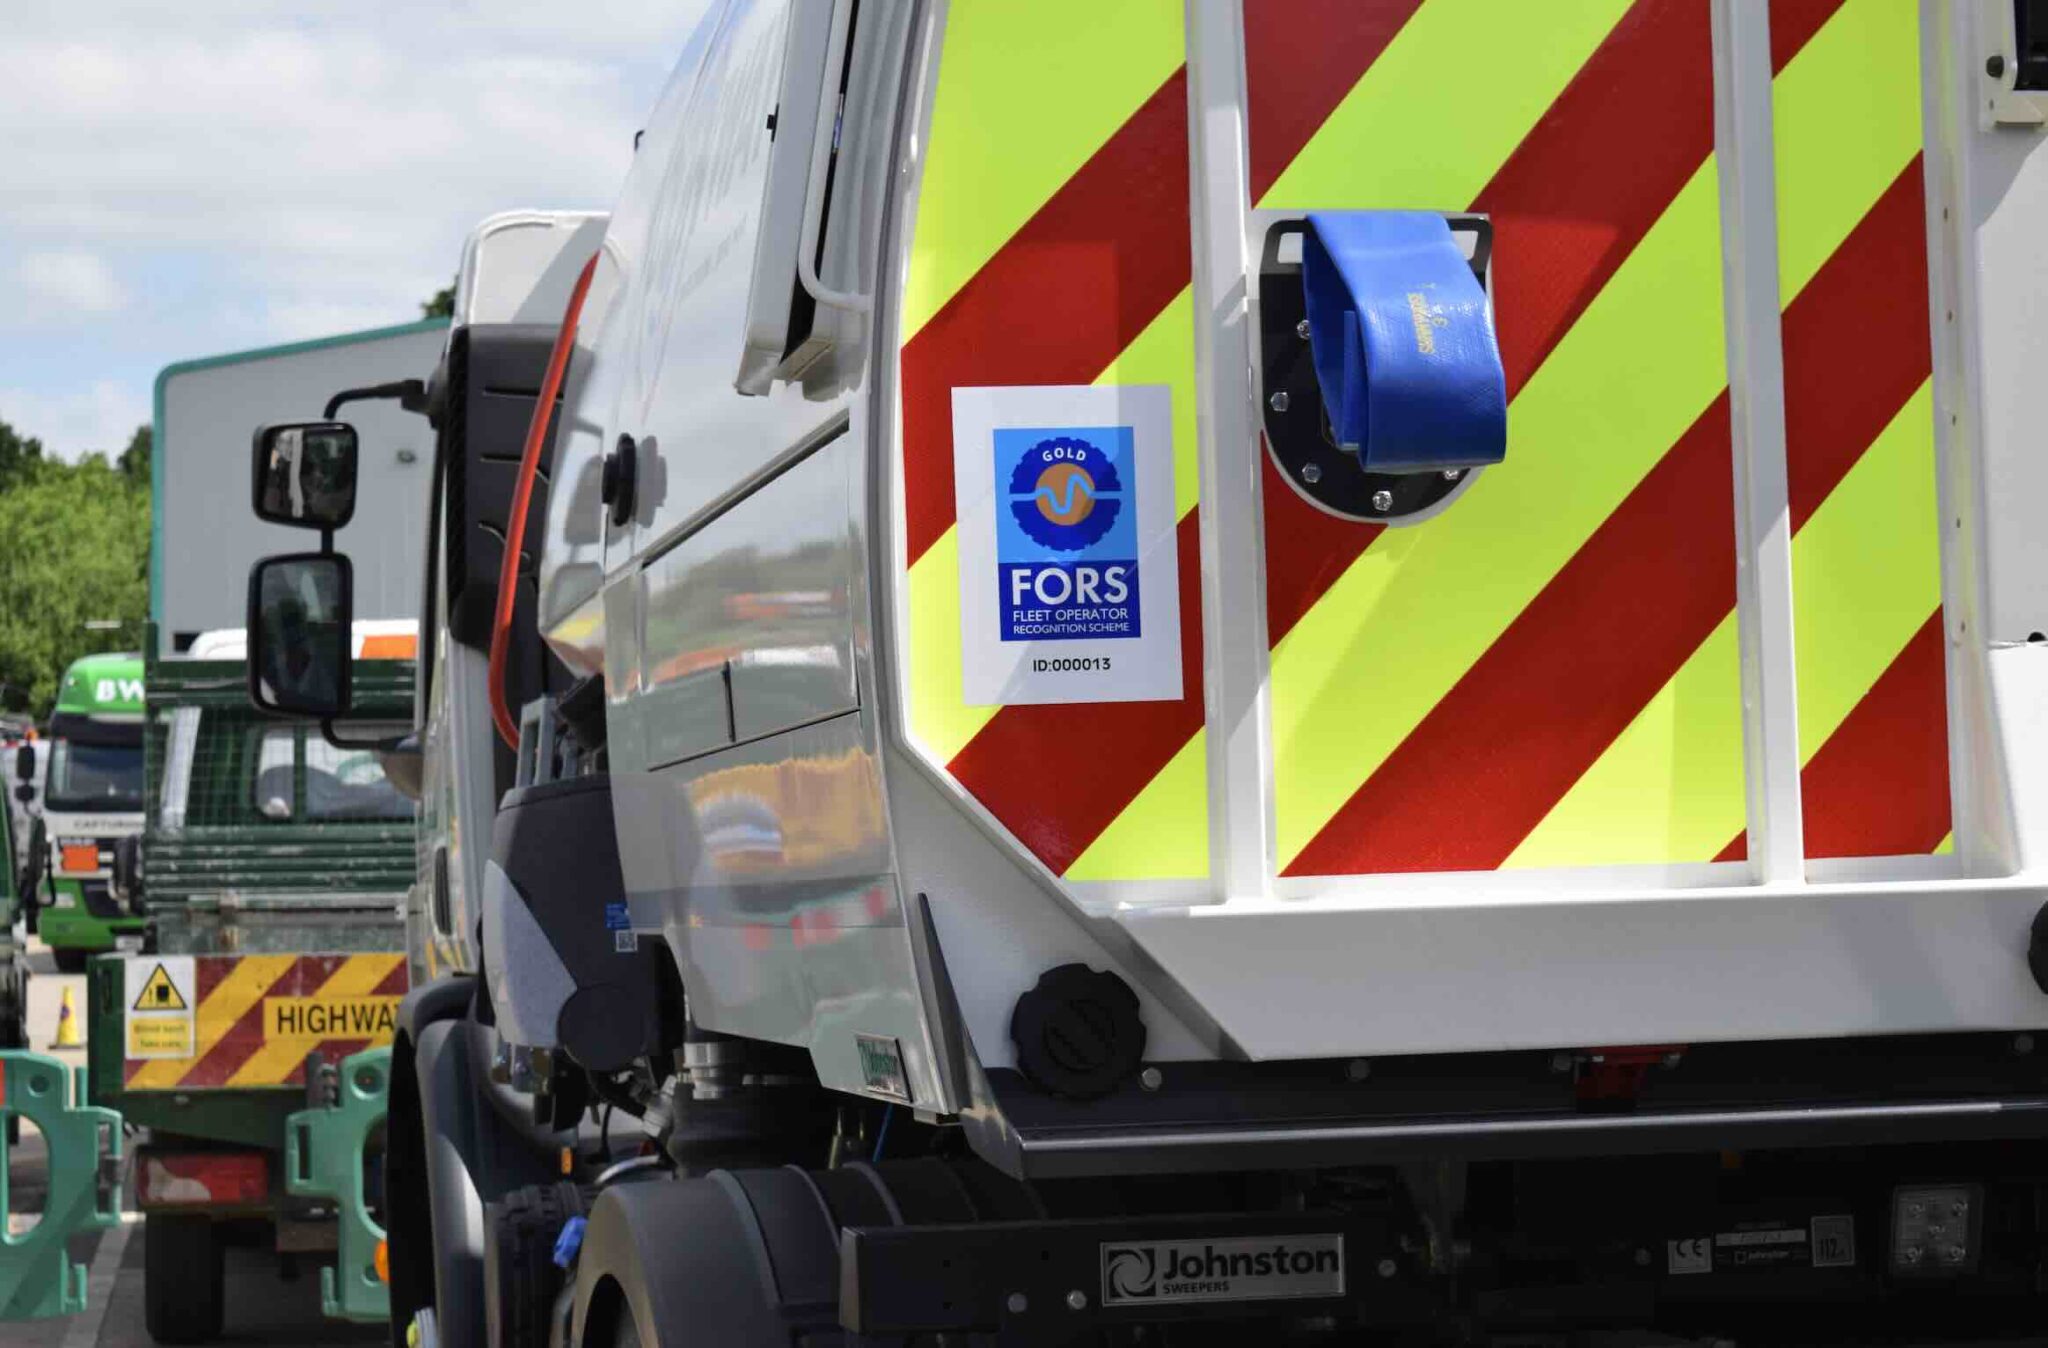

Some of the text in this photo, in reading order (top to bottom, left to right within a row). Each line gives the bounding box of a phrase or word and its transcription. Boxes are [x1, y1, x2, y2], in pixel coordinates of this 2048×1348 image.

[1042, 447, 1086, 462] GOLD
[1011, 566, 1129, 605] FORS
[1013, 608, 1129, 622] FLEET OPERATOR
[1013, 622, 1130, 634] RECOGNITION SCHEME
[1033, 657, 1111, 672] ID:000013
[277, 1003, 398, 1034] HIGHWA
[1163, 1245, 1339, 1280] Johnston
[1163, 1281, 1230, 1295] SWEEPERS
